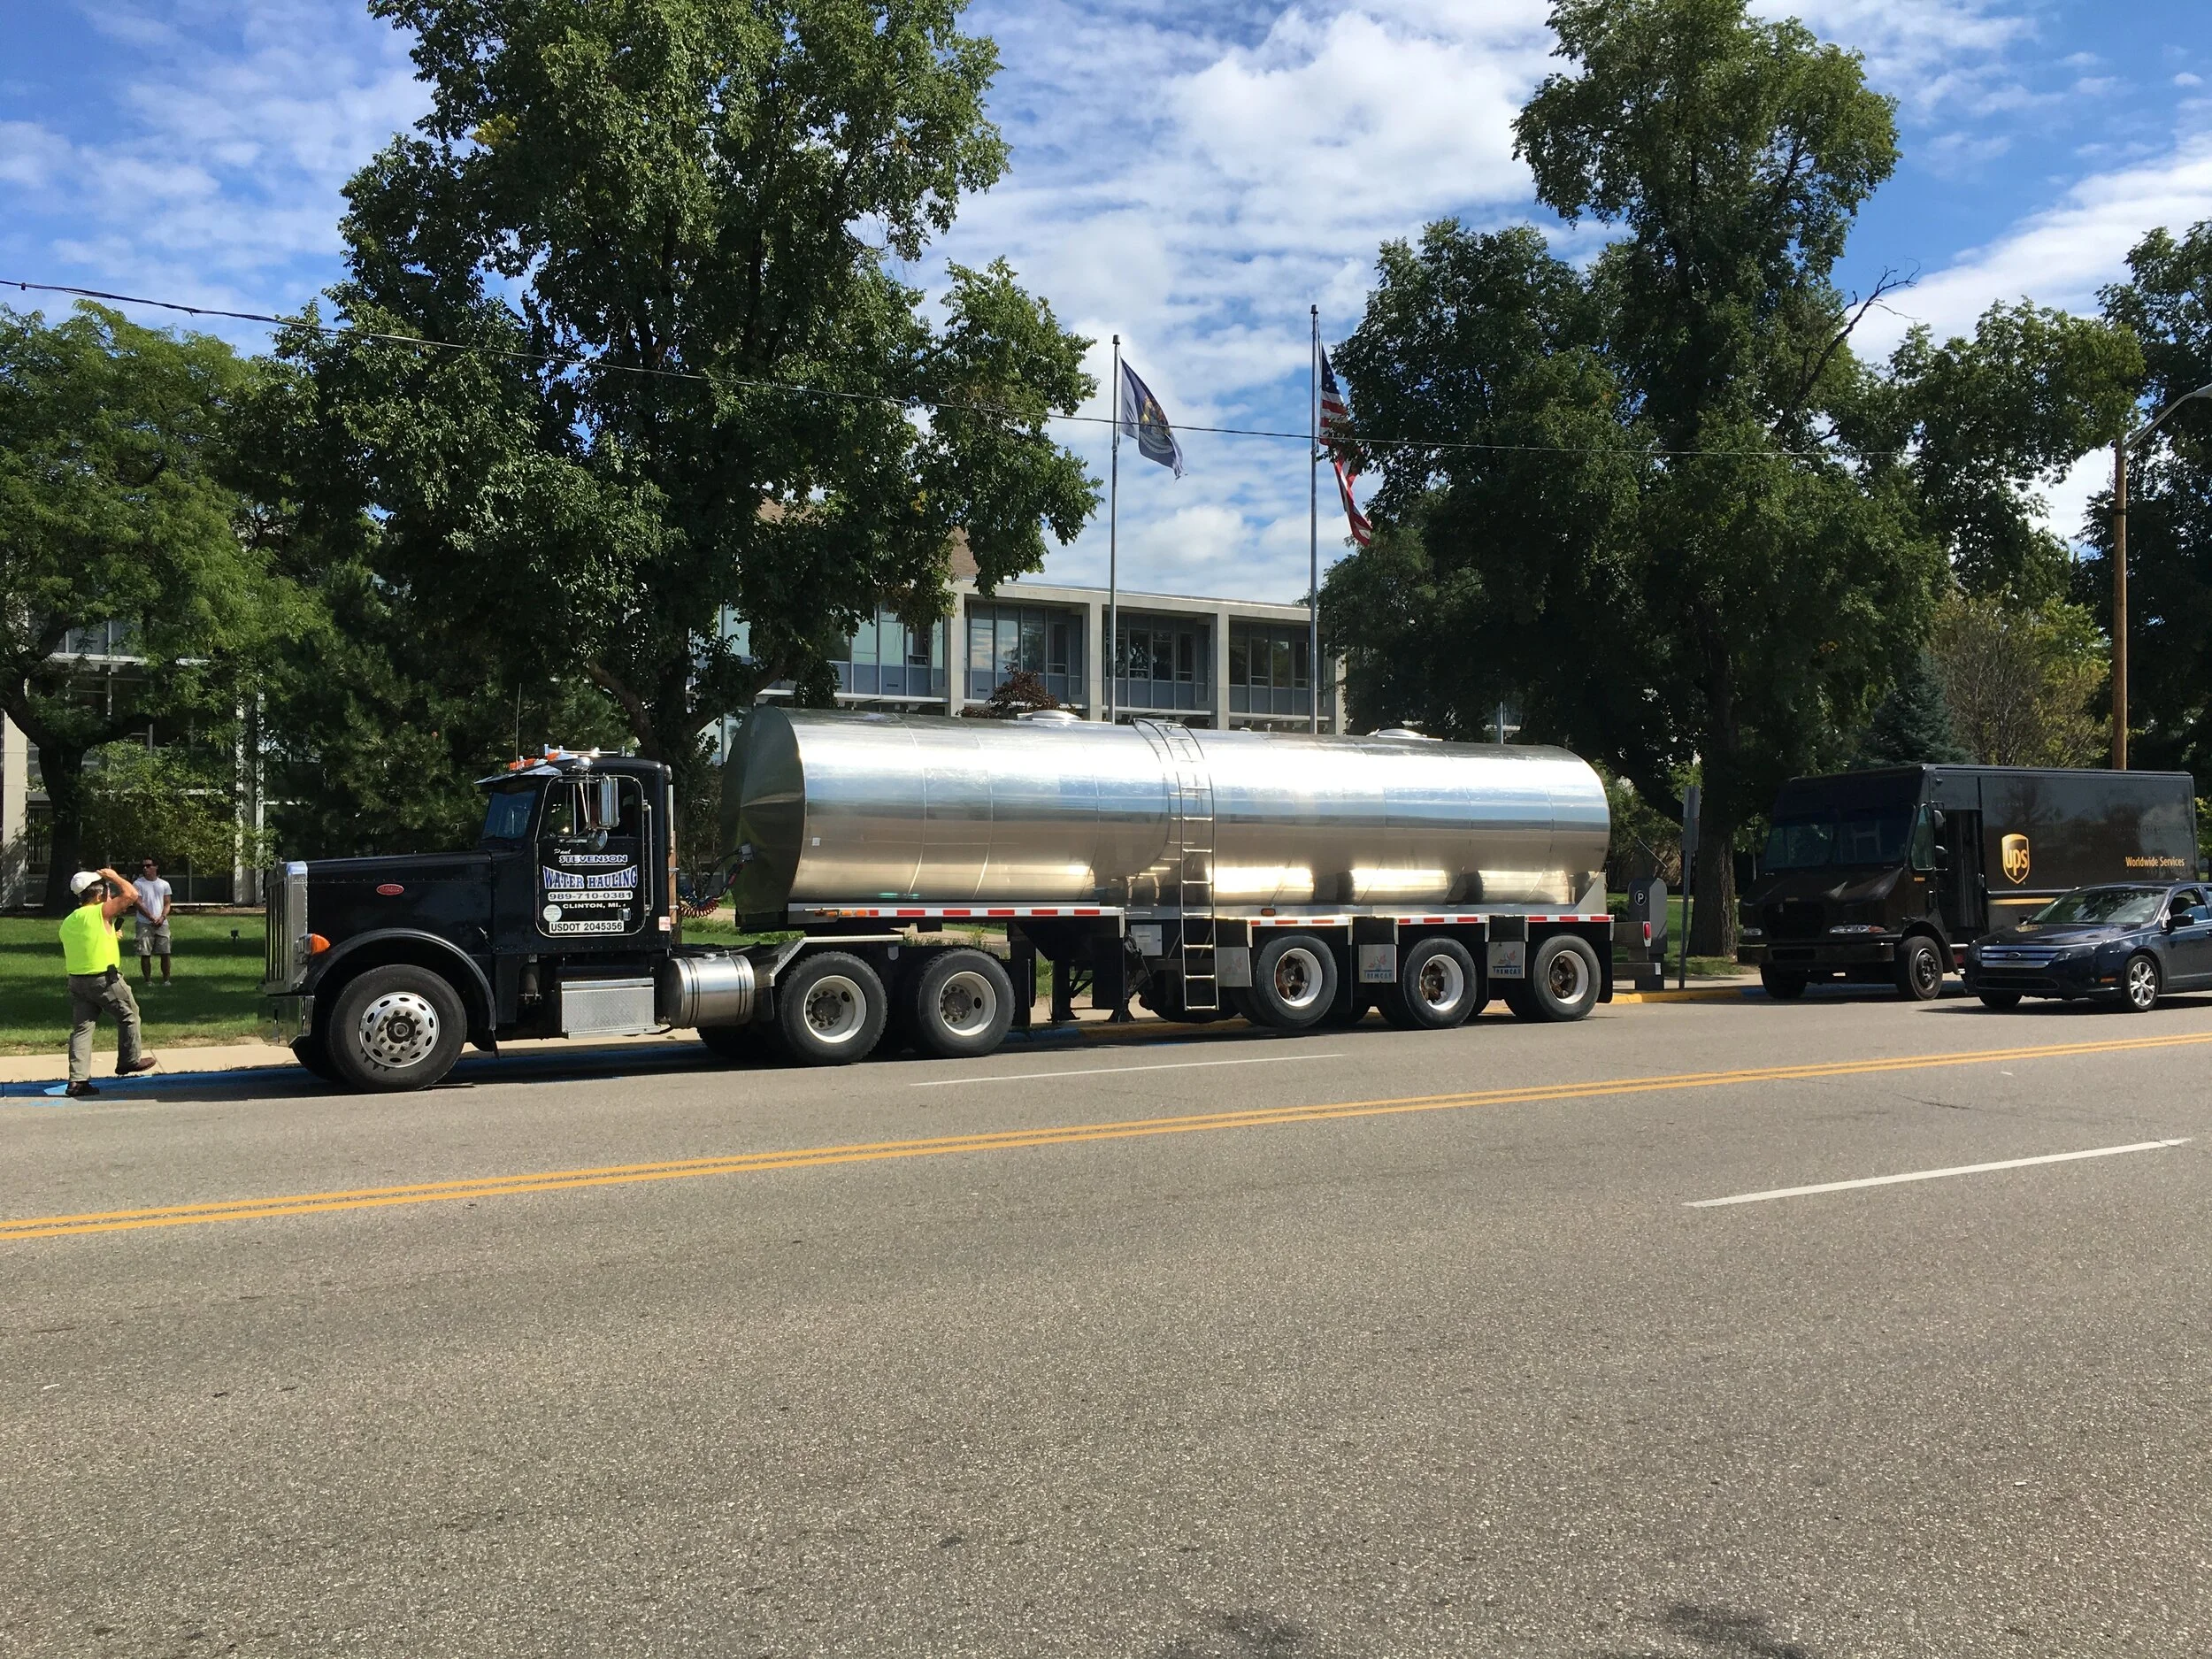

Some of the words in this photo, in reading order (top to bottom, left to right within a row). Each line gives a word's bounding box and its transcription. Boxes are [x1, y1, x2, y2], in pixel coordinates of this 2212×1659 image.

[2005, 849, 2028, 876] ups
[2125, 856, 2158, 866] Worldwide
[2160, 856, 2185, 866] Services
[543, 865, 584, 889] WATER
[588, 864, 637, 888] HAULING
[551, 923, 580, 932] USDOT
[584, 922, 622, 931] 2045356
